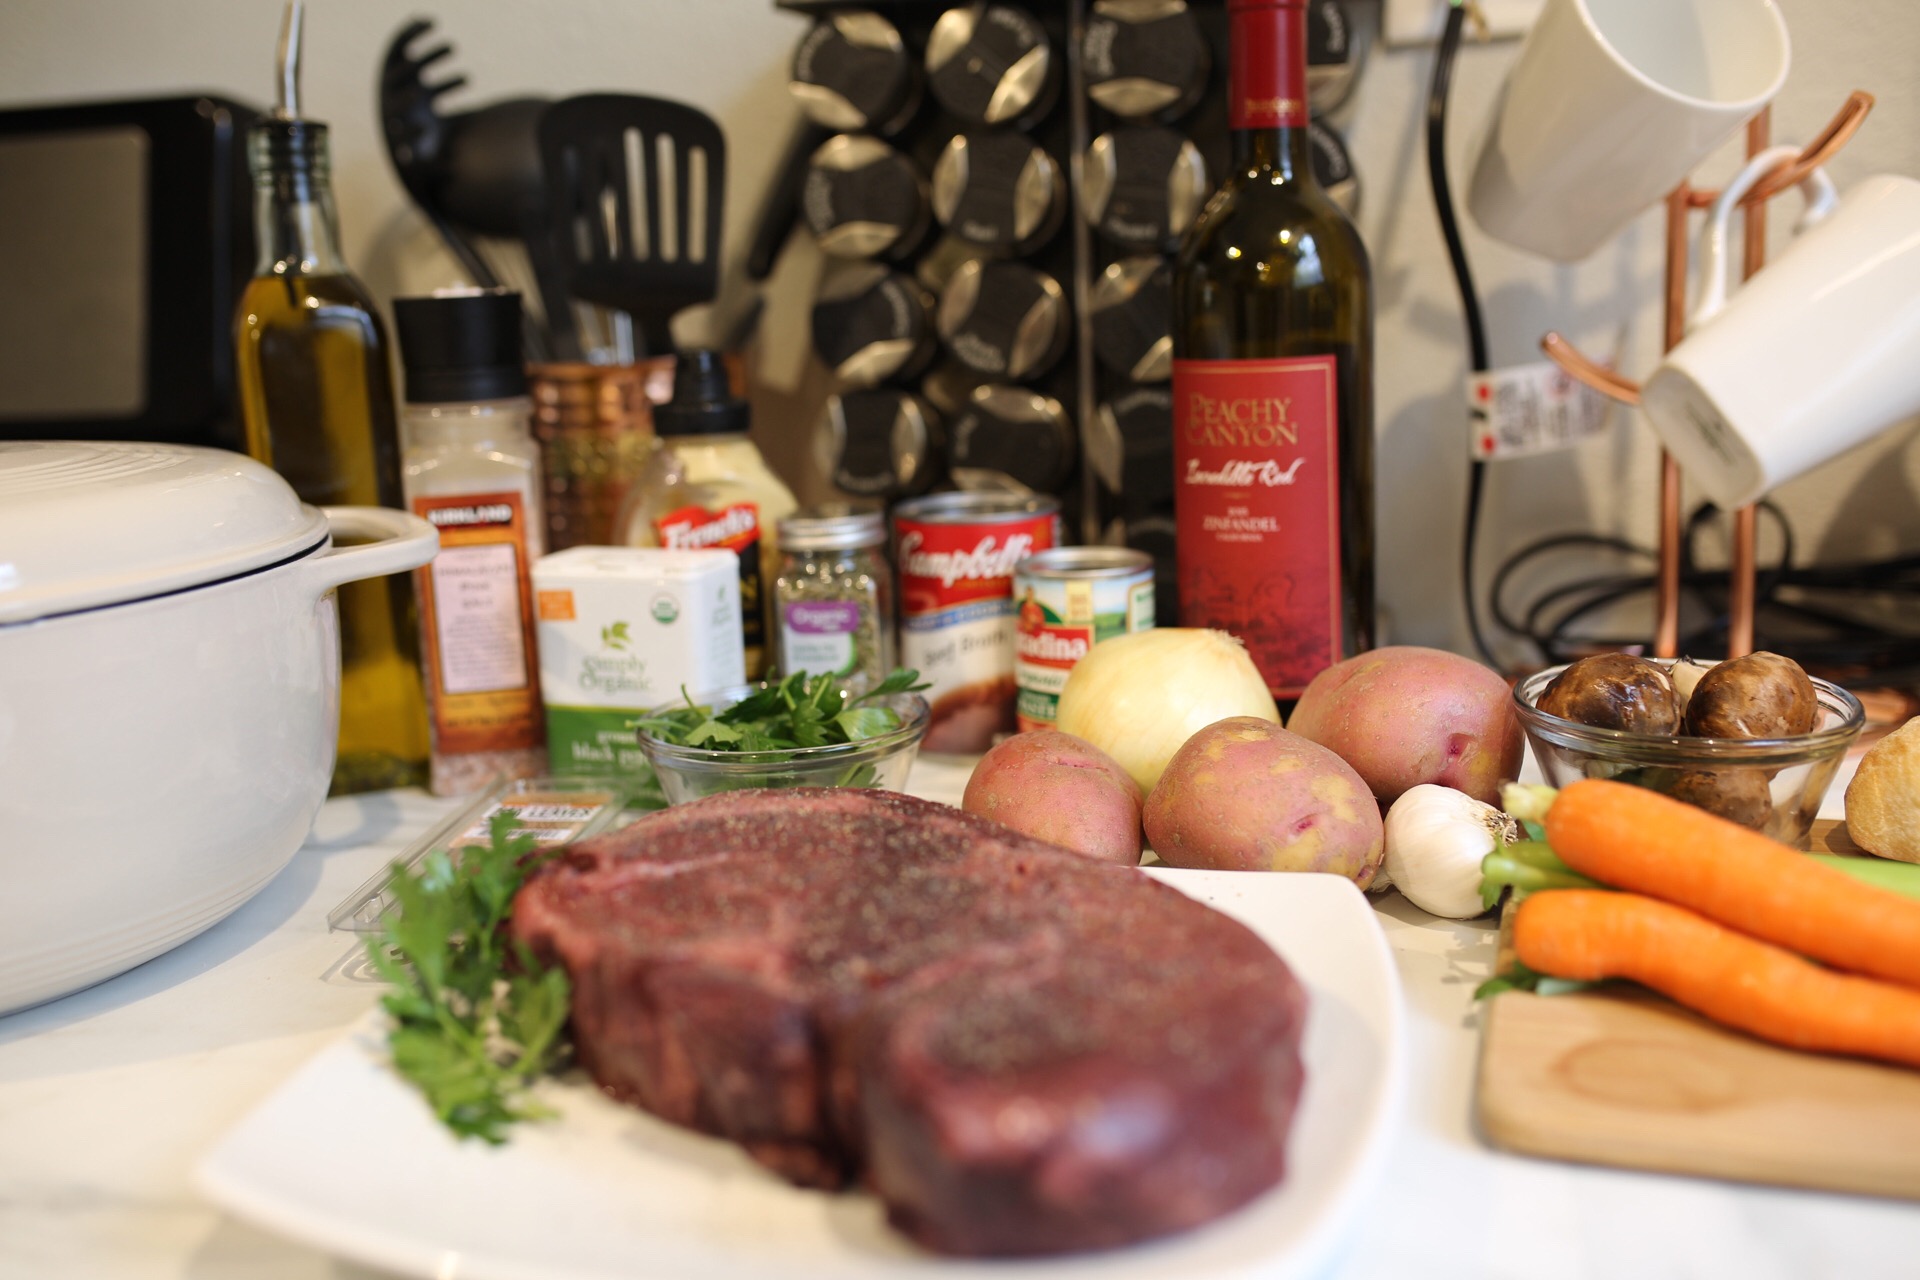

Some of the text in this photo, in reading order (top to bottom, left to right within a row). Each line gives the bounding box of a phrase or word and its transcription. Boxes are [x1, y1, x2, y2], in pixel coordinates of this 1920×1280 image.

[1189, 391, 1292, 427] PEACHY
[1186, 421, 1299, 448] CANYON
[1258, 456, 1306, 488] Red
[427, 504, 513, 527] KIRKLAND
[1203, 516, 1281, 533] ZINFANDEL
[582, 653, 647, 674] Simply
[578, 669, 653, 696] Organic
